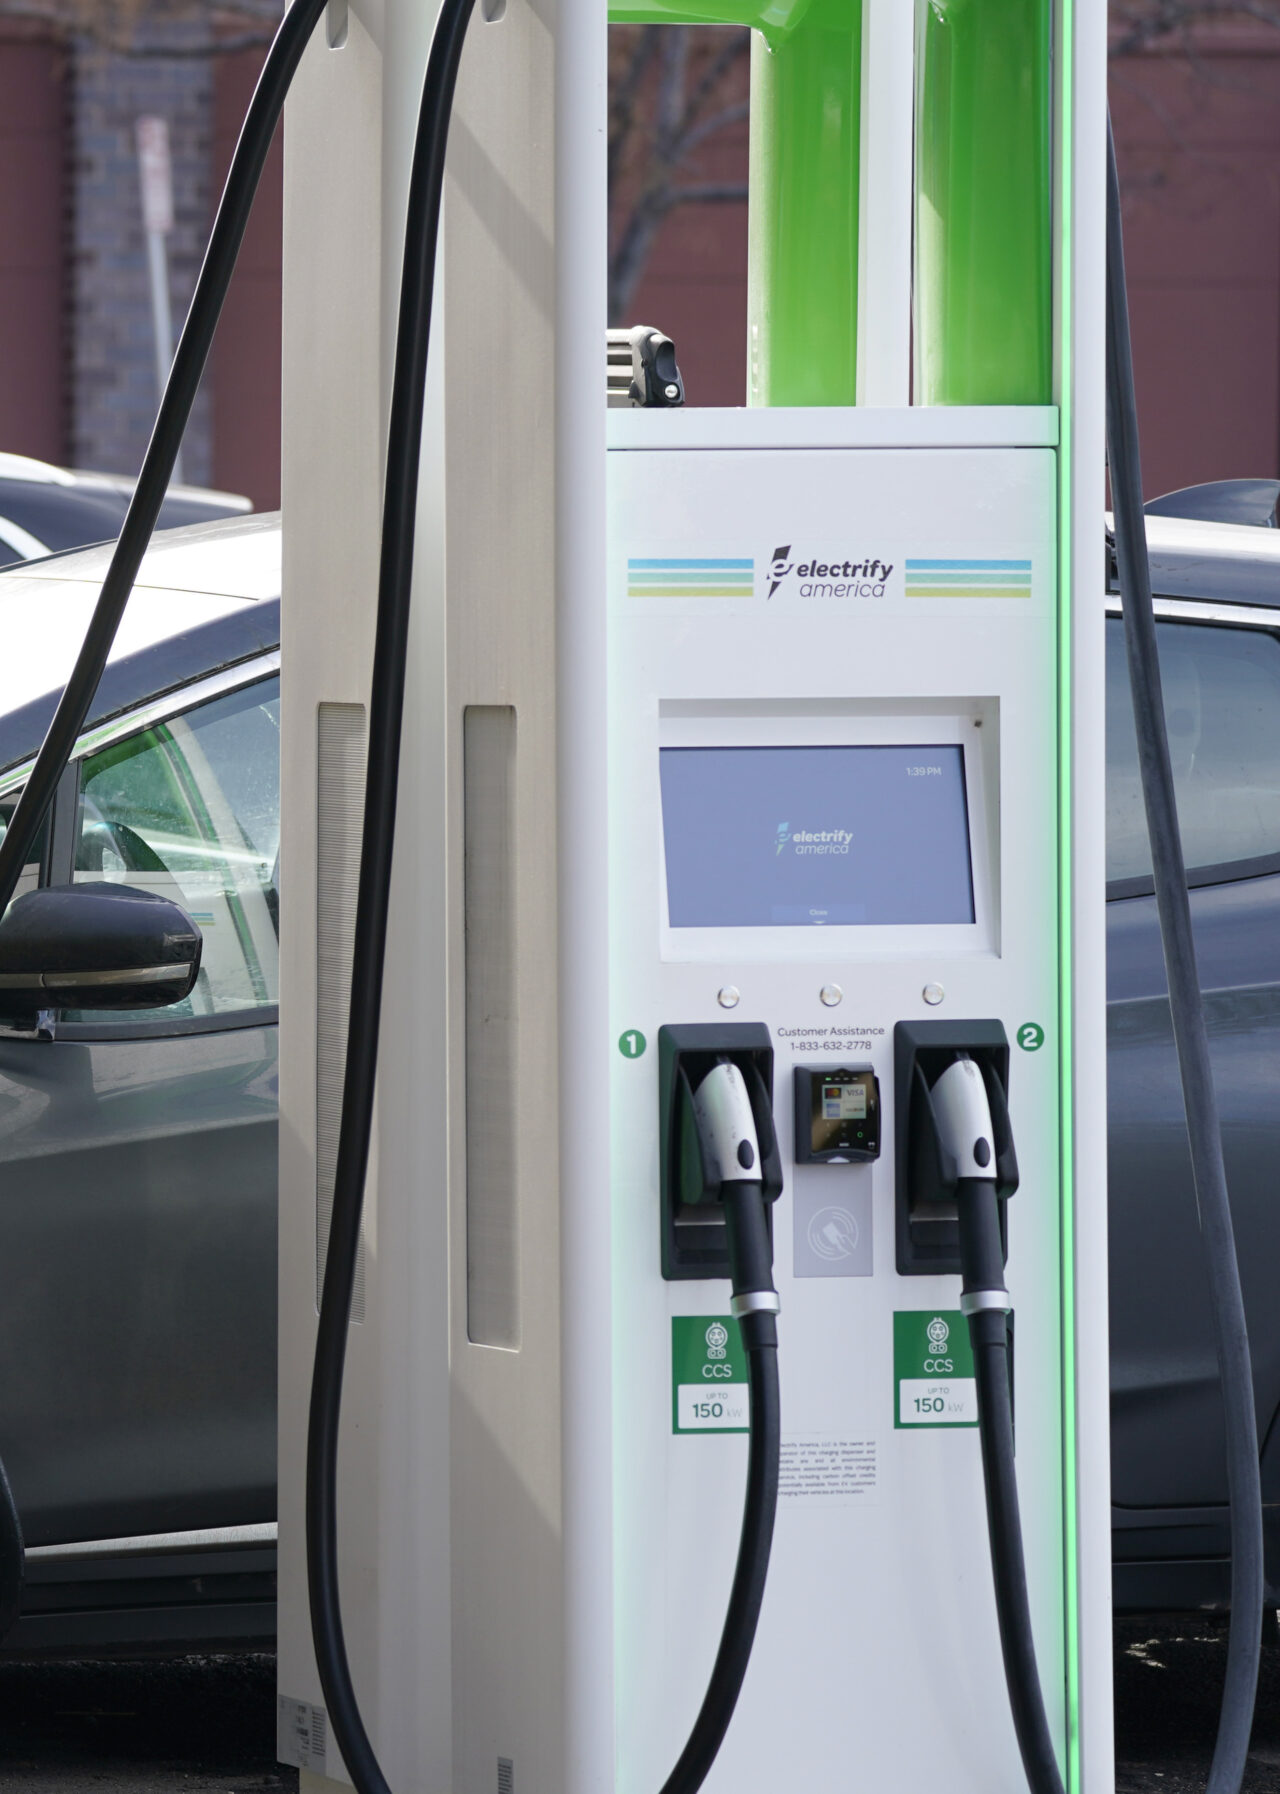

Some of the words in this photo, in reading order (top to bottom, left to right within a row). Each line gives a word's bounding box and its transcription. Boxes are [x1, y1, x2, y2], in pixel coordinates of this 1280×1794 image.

[797, 559, 893, 582] electrify
[800, 580, 885, 597] america
[927, 767, 942, 776] PM
[793, 829, 853, 845] electrify
[795, 842, 849, 855] america
[777, 1027, 829, 1037] Customer
[830, 1026, 885, 1036] Assistance
[1023, 1027, 1038, 1048] 2
[625, 1034, 639, 1055] 1
[790, 1041, 872, 1051] 1-833-632-2778
[847, 1089, 865, 1097] VISA
[702, 1364, 733, 1378] CCS
[923, 1358, 954, 1373] CCS
[692, 1402, 724, 1418] 150
[914, 1397, 945, 1413] 150
